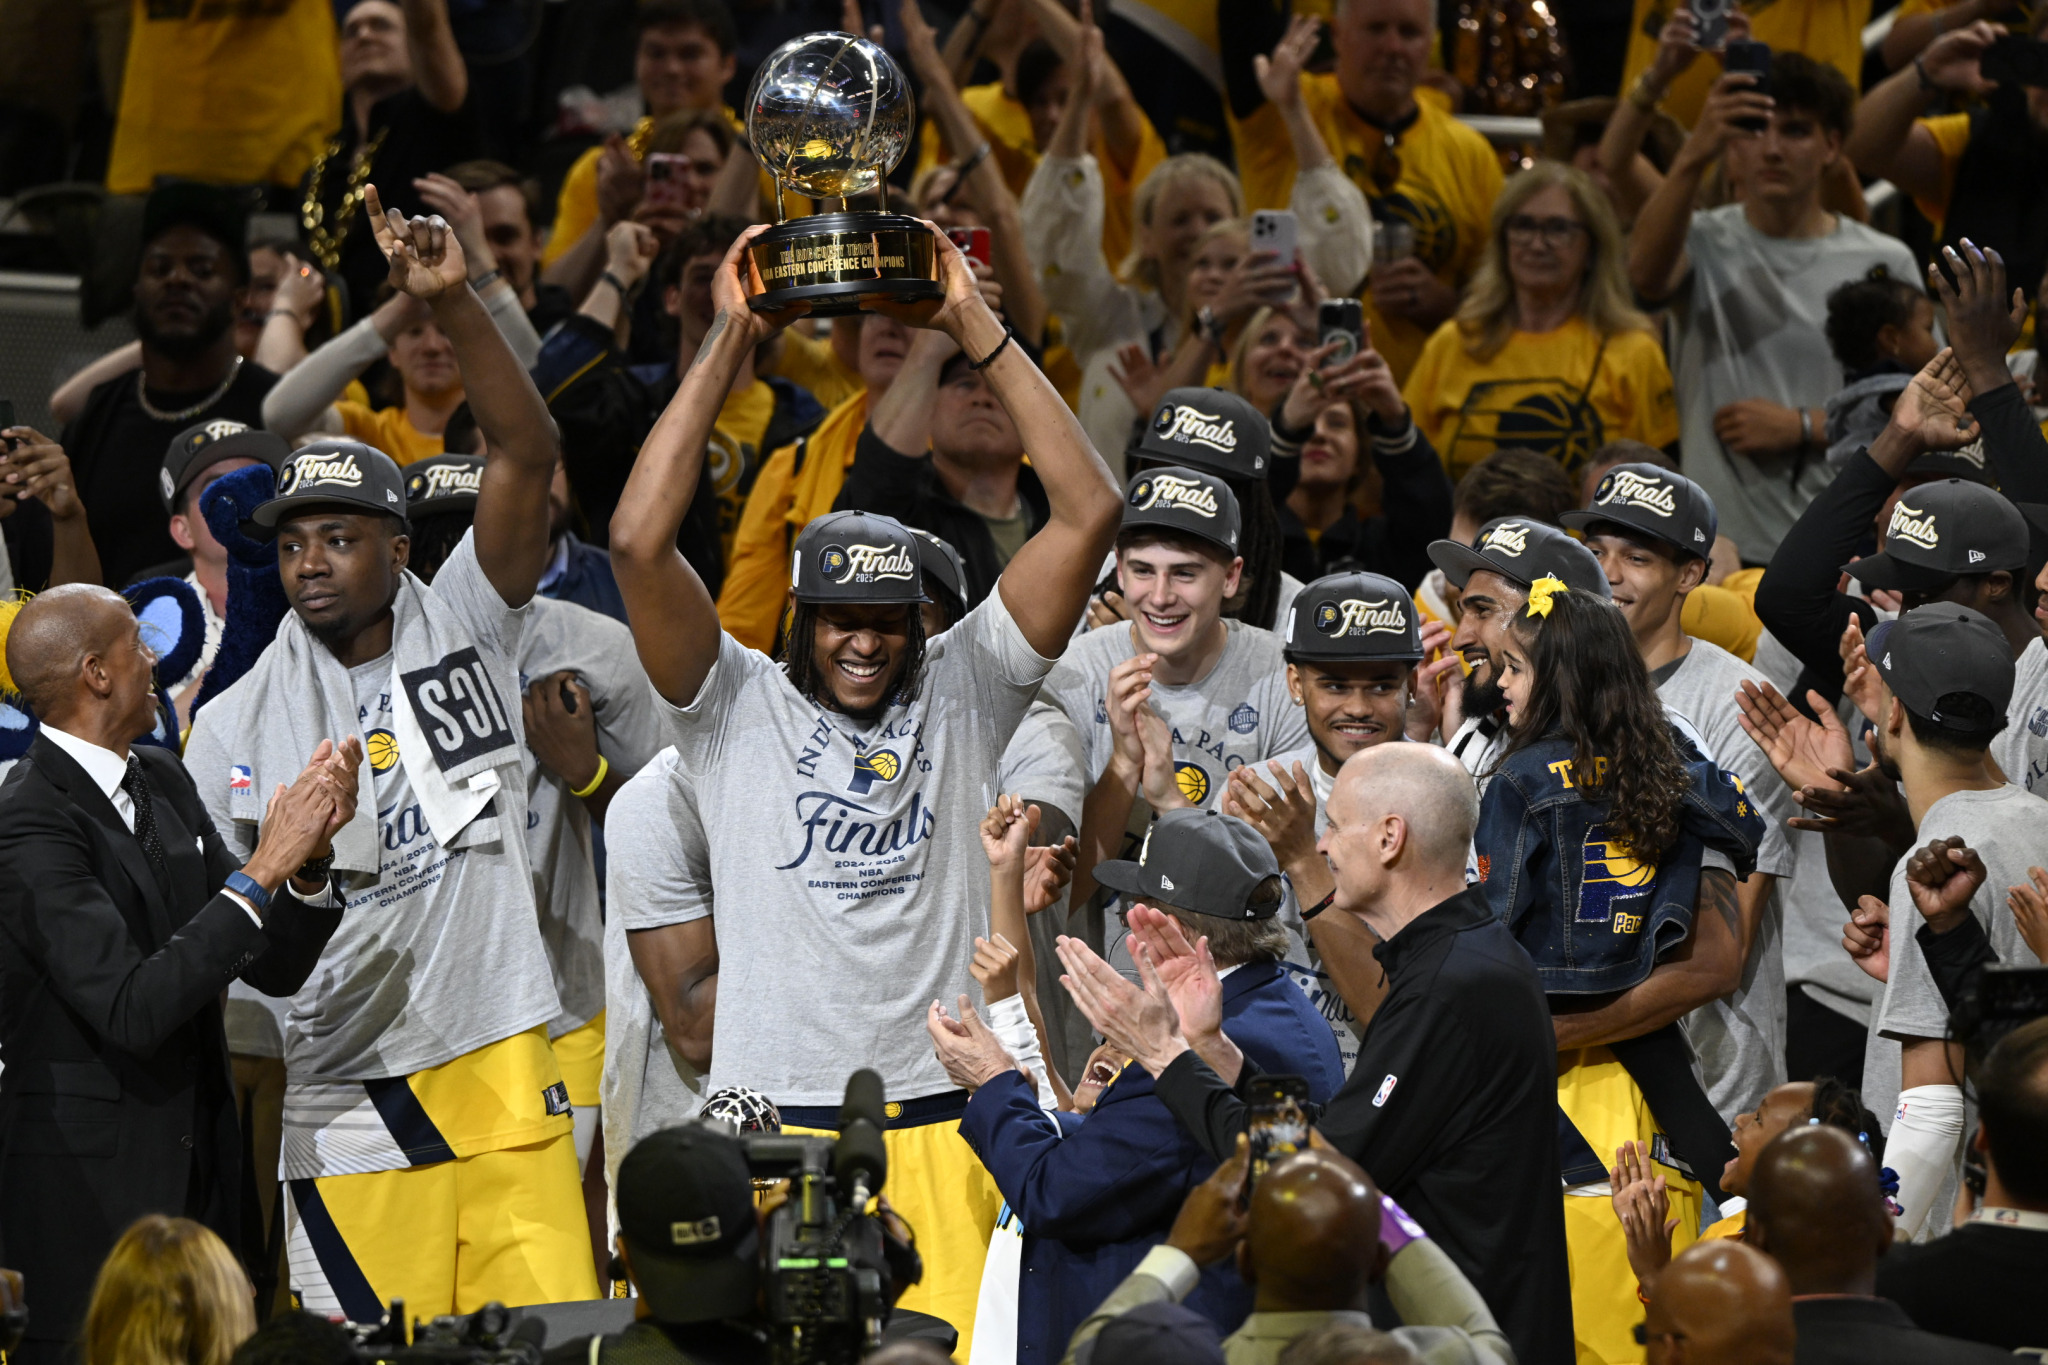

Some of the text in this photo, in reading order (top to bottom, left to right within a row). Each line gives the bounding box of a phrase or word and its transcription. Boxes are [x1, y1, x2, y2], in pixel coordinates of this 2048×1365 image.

[774, 262, 806, 278] EASTERN
[808, 257, 860, 274] CONFERENCE
[861, 255, 905, 269] CHAMPIONS
[1160, 404, 1237, 453] Finals
[1174, 432, 1190, 443] 2025
[285, 451, 363, 496] Finals
[299, 478, 314, 489] 2025
[425, 463, 484, 499] Final
[1138, 475, 1219, 518] Finals
[1154, 499, 1171, 509] 2025
[1598, 471, 1676, 518] Finals
[836, 543, 914, 585] Finals
[855, 573, 874, 583] 2025
[1329, 599, 1407, 638] Finals
[1348, 626, 1366, 636] 2025
[796, 715, 869, 779] INDIA
[1195, 730, 1245, 772] PAC
[774, 790, 936, 870] Finals
[406, 842, 434, 860] 2025
[834, 860, 865, 868] 2024
[875, 854, 906, 865] 2025
[346, 851, 462, 910] EASTERN CONFERENCE
[394, 863, 418, 878] NBA
[808, 873, 925, 889] EASTERN CONFEREN
[858, 868, 884, 877] NBA
[379, 873, 442, 908] CHAMPIONS
[837, 886, 905, 900] CHAMPIONS
[1613, 911, 1644, 934] Pac
